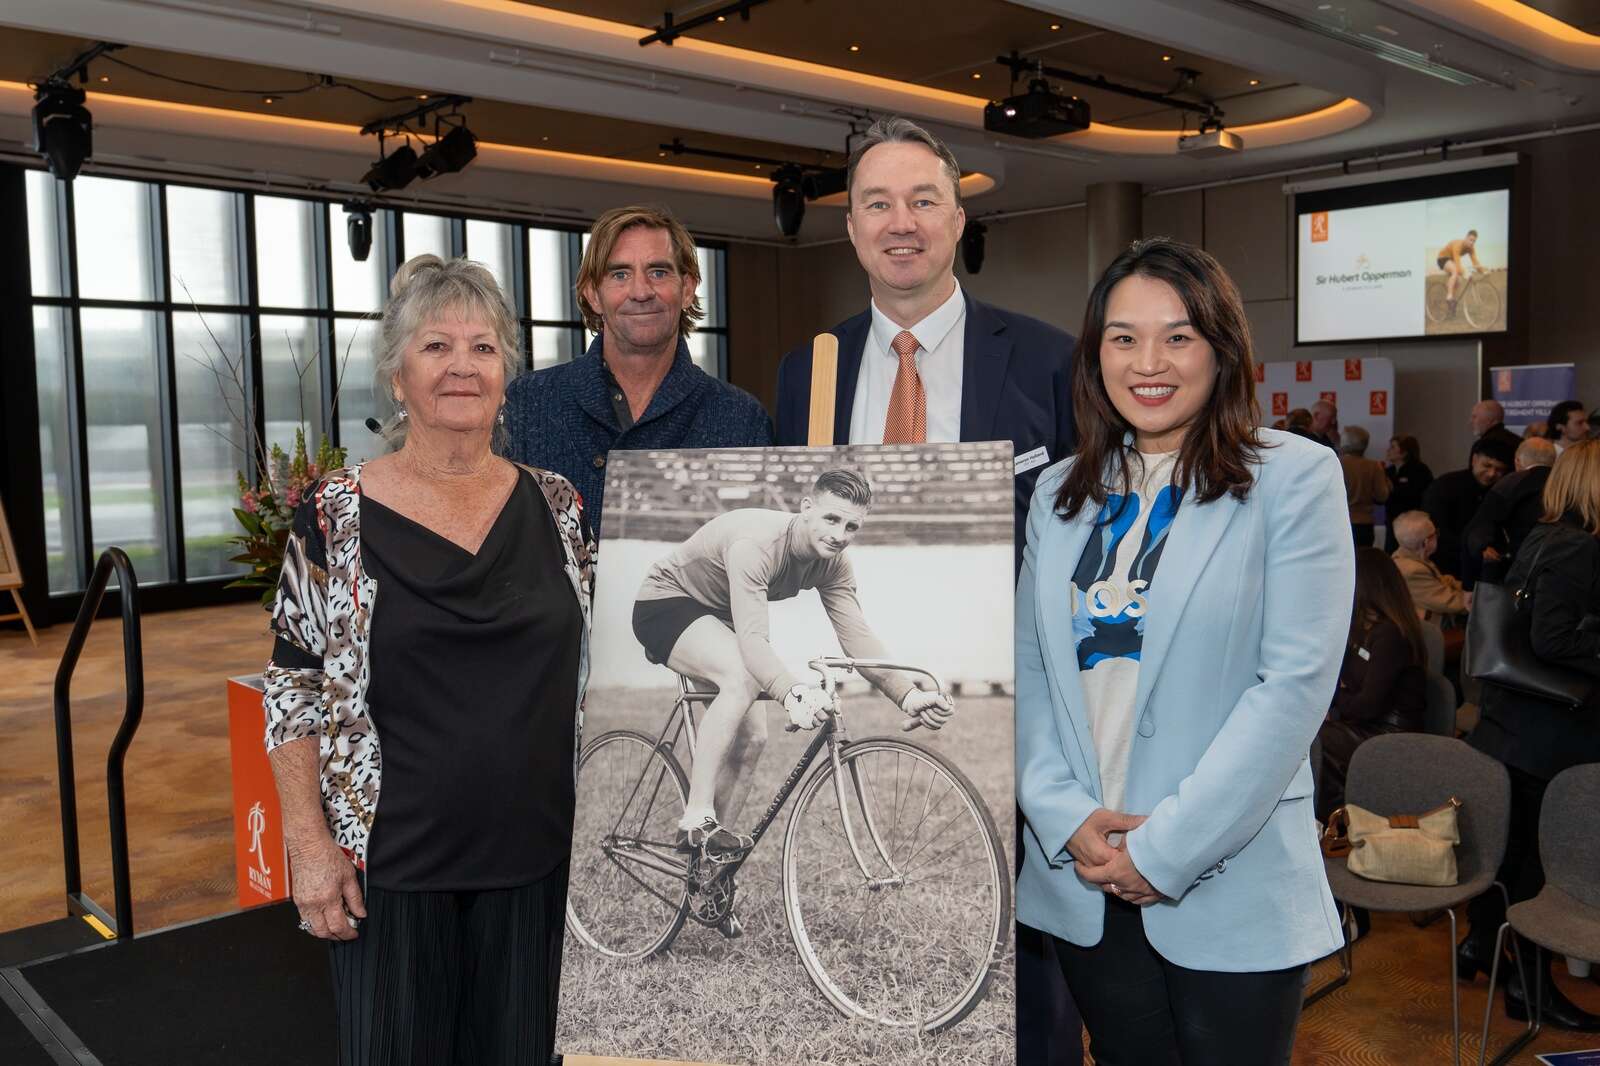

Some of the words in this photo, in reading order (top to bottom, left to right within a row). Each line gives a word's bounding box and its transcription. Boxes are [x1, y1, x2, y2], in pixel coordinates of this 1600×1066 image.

[1316, 275, 1327, 285] Sir
[1329, 273, 1360, 284] Hubert
[1361, 269, 1412, 283] Opperman
